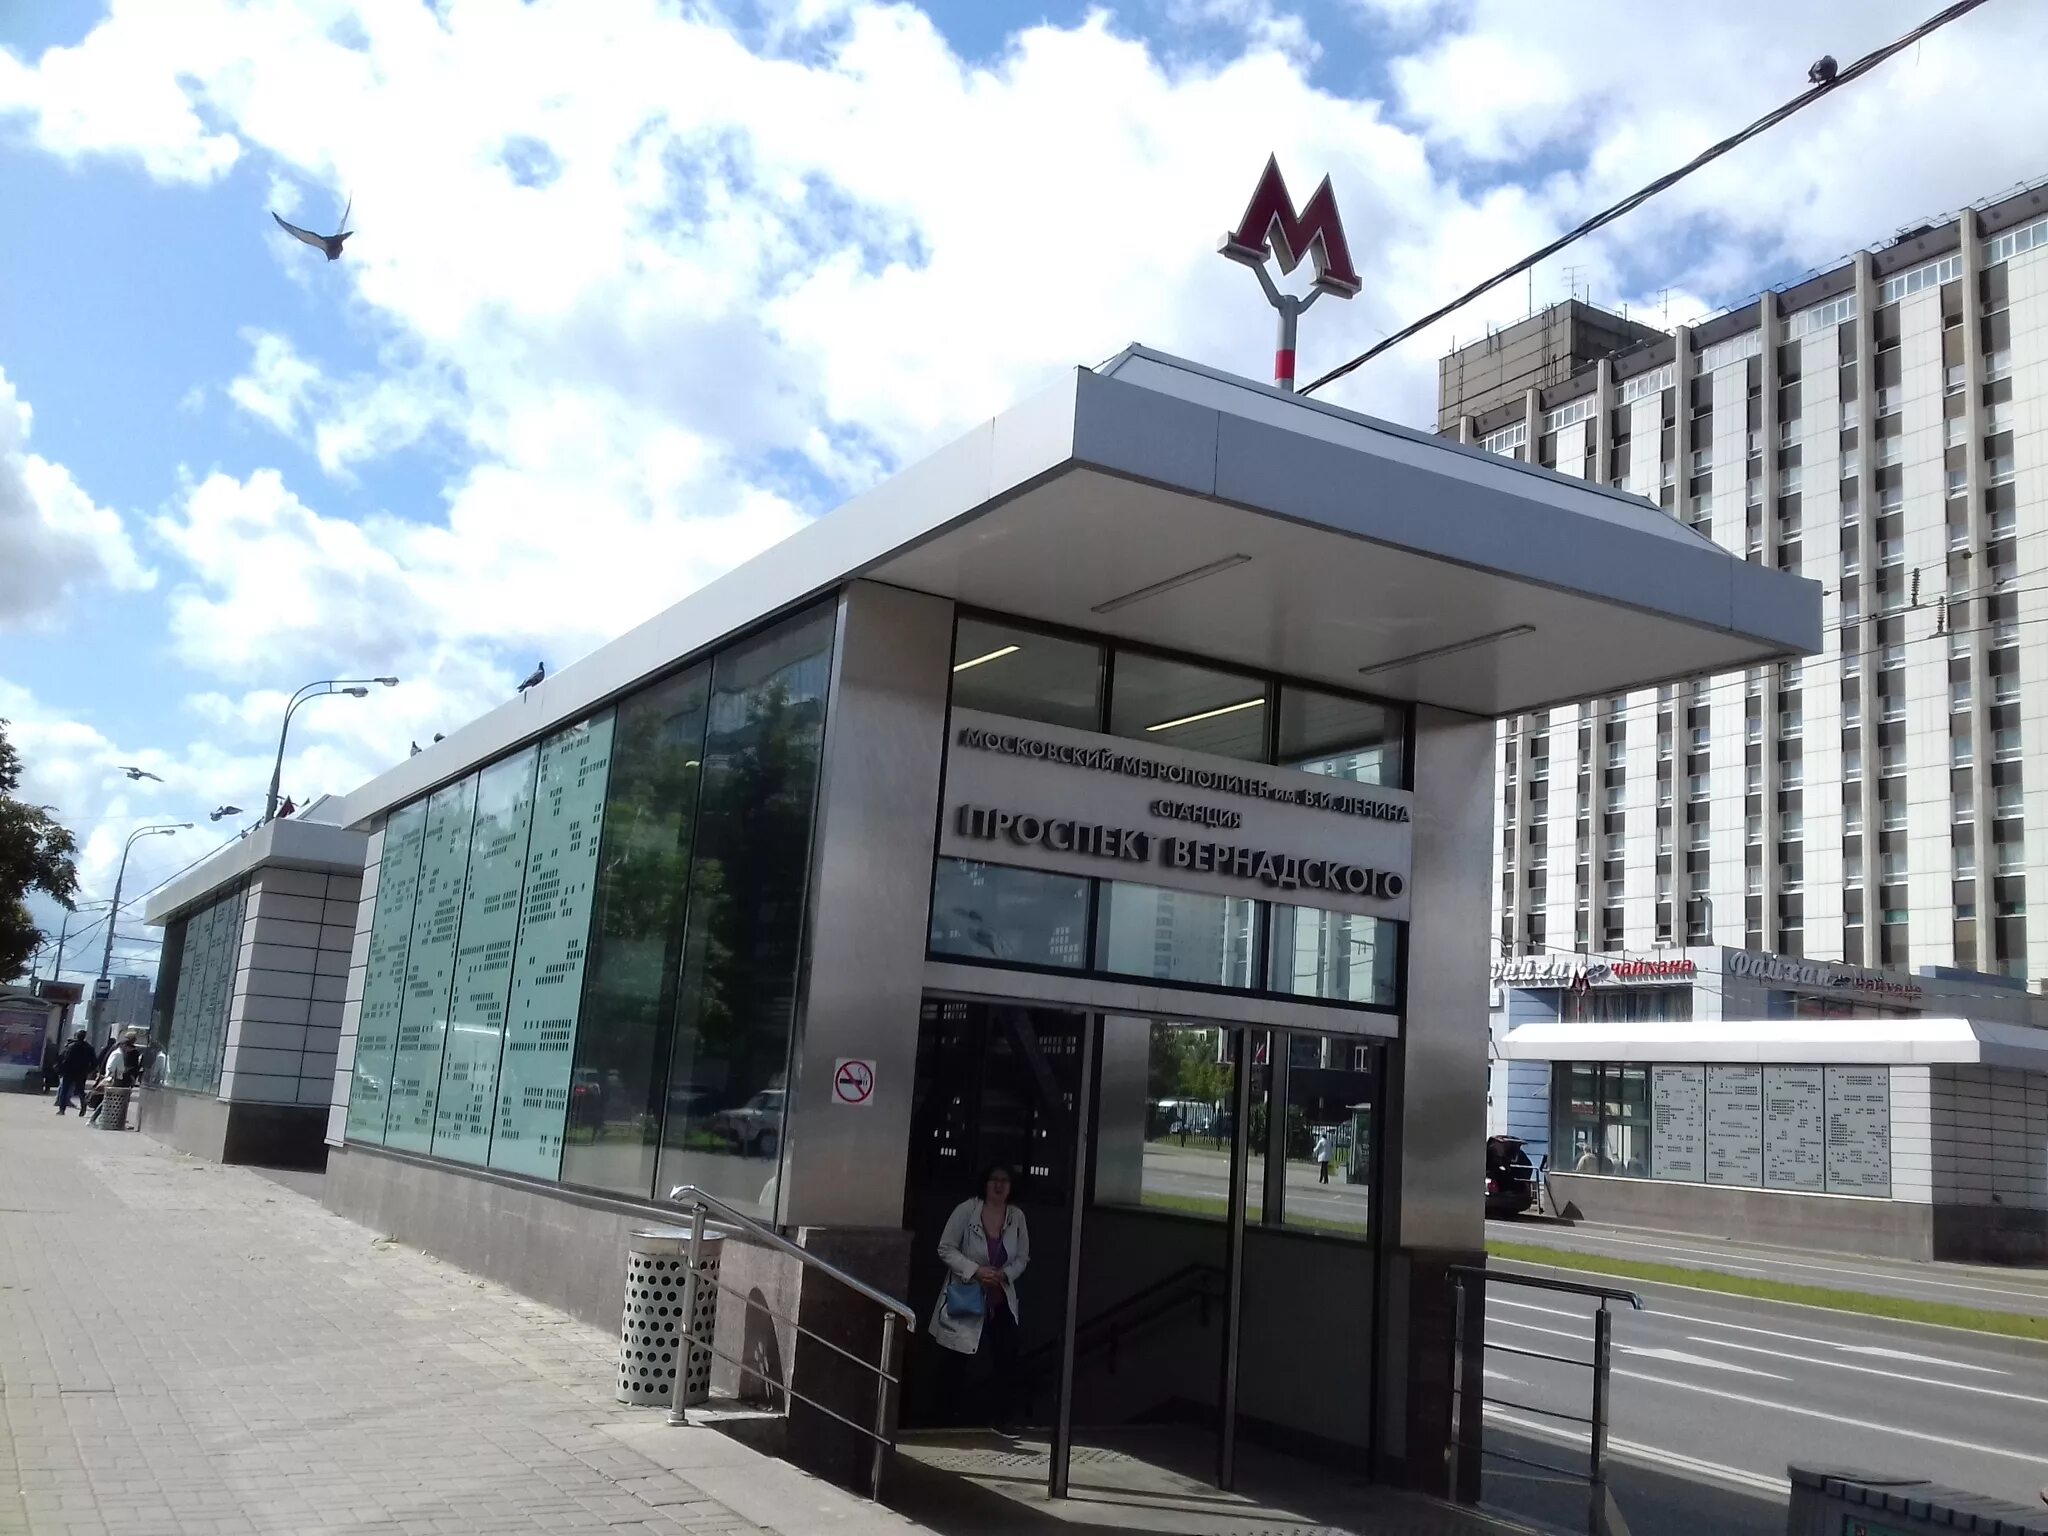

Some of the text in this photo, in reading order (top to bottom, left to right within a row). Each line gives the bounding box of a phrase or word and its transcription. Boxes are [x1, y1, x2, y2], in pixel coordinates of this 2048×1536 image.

[962, 727, 1116, 772] МОСКОВСКИЙ
[1121, 755, 1269, 799] МЕТРОПОЛИТЕН
[1341, 795, 1411, 823] ЛЕНИНА
[1155, 799, 1243, 829] СТАНЦИЯ
[963, 803, 1406, 899] ПРОСПЕКТ ВЕРНАДСКОГО
[1611, 957, 1694, 979] чайхана
